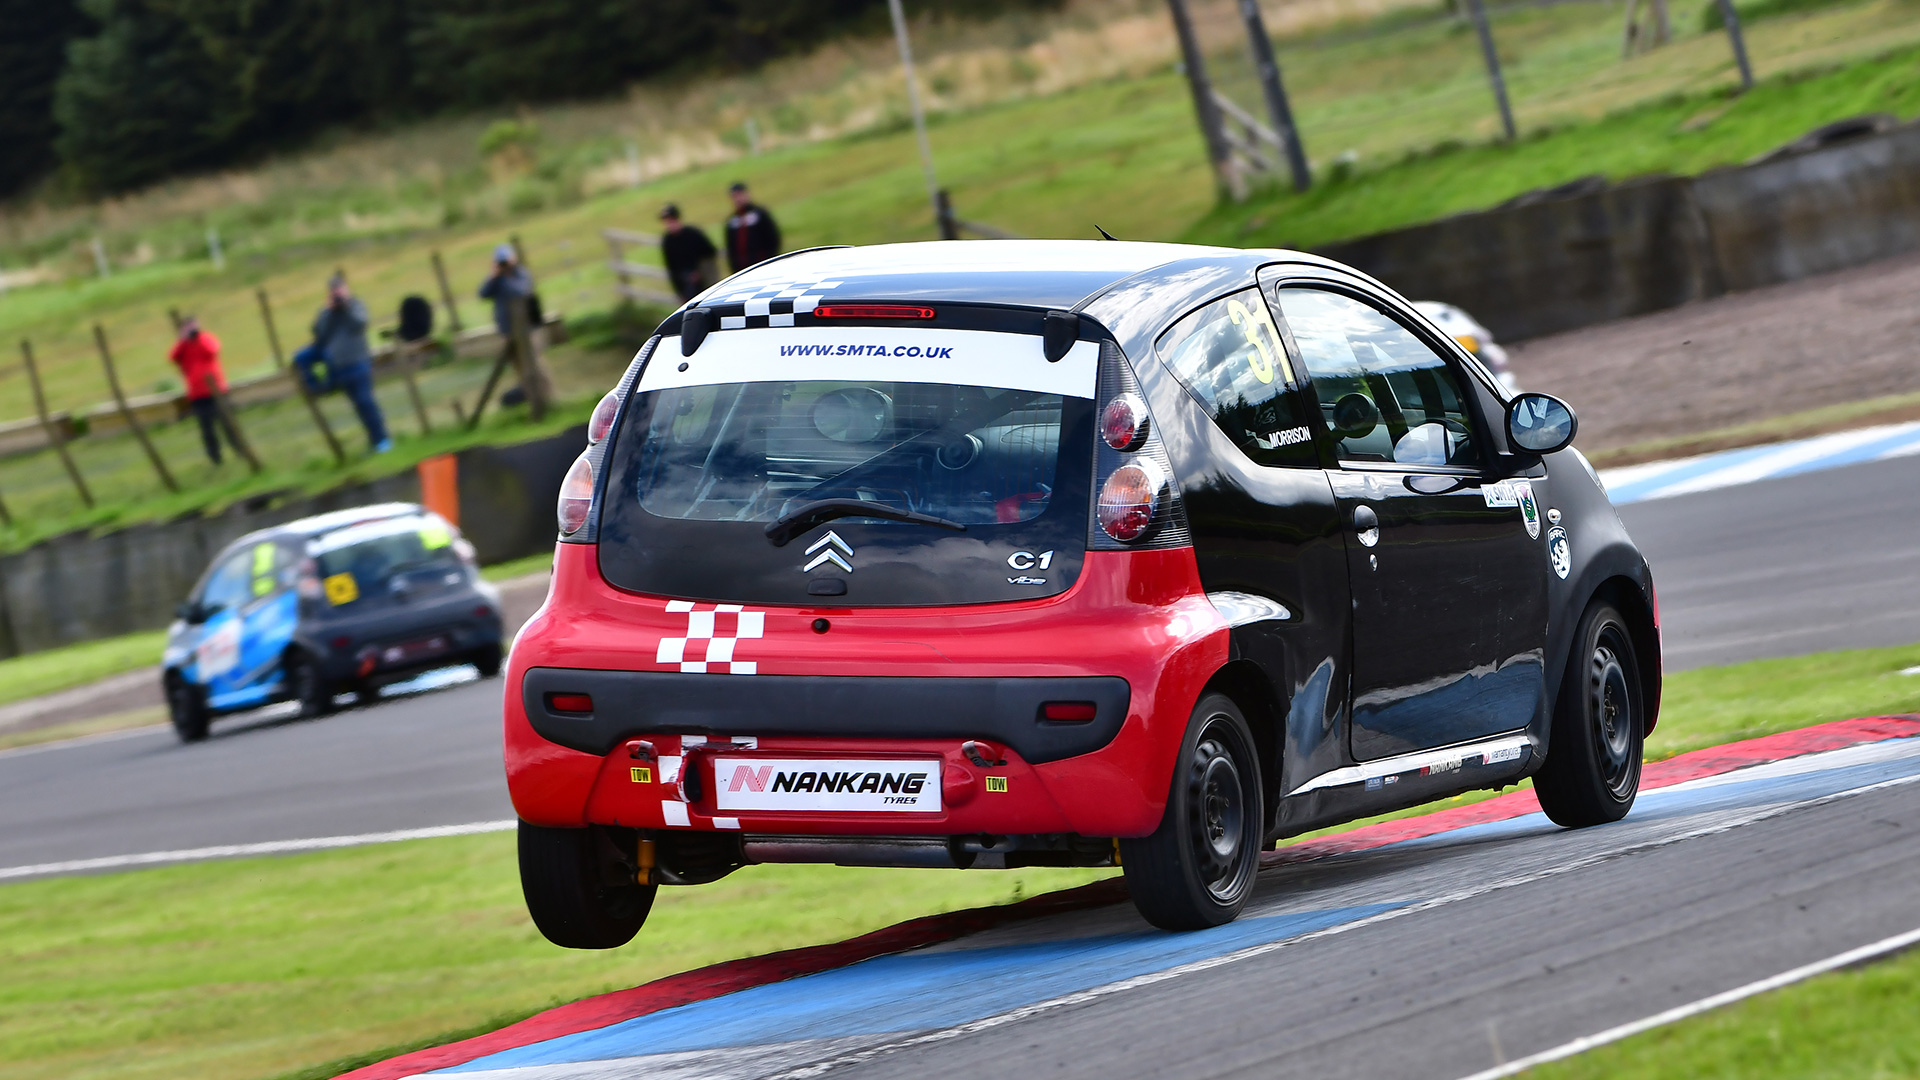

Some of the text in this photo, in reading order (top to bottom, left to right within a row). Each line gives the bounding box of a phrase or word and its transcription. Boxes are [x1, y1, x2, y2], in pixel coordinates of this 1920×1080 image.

[780, 344, 954, 359] WWW.SMTA.CO.UK
[1269, 426, 1311, 448] MORRISON
[1007, 550, 1054, 570] C1
[632, 768, 649, 781] TOW
[771, 772, 927, 793] NANKANG
[987, 777, 1005, 791] TOW
[883, 796, 917, 805] TYRES
